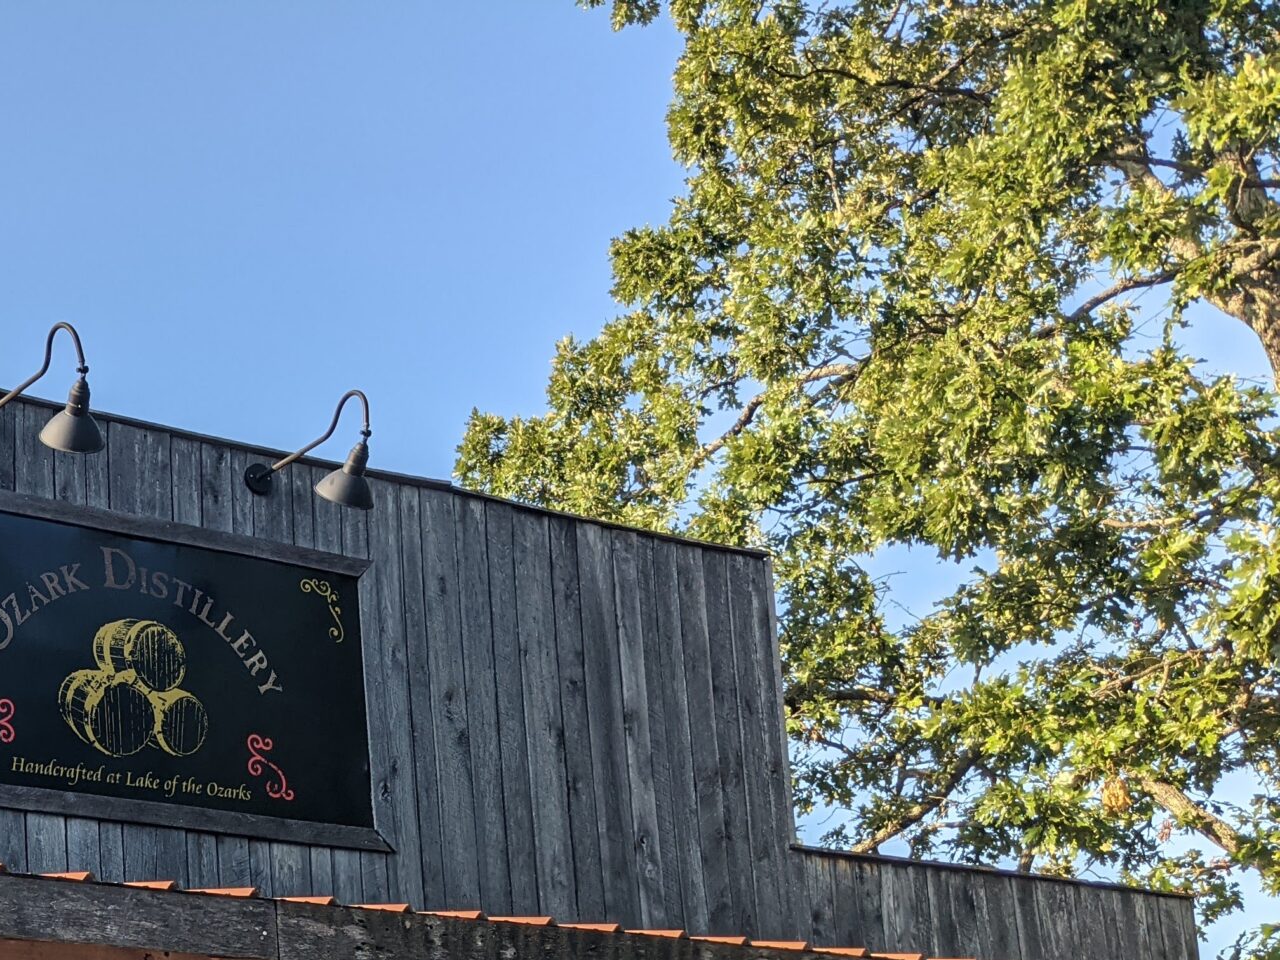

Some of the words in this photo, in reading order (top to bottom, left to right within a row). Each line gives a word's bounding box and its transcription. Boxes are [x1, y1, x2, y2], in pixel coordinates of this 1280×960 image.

[100, 546, 283, 695] DISTILLERY
[10, 757, 102, 785] Handcrafted
[106, 774, 122, 784] at
[126, 771, 159, 789] Lake
[163, 775, 180, 797] of
[181, 777, 202, 794] the
[206, 781, 252, 800] Ozarks
